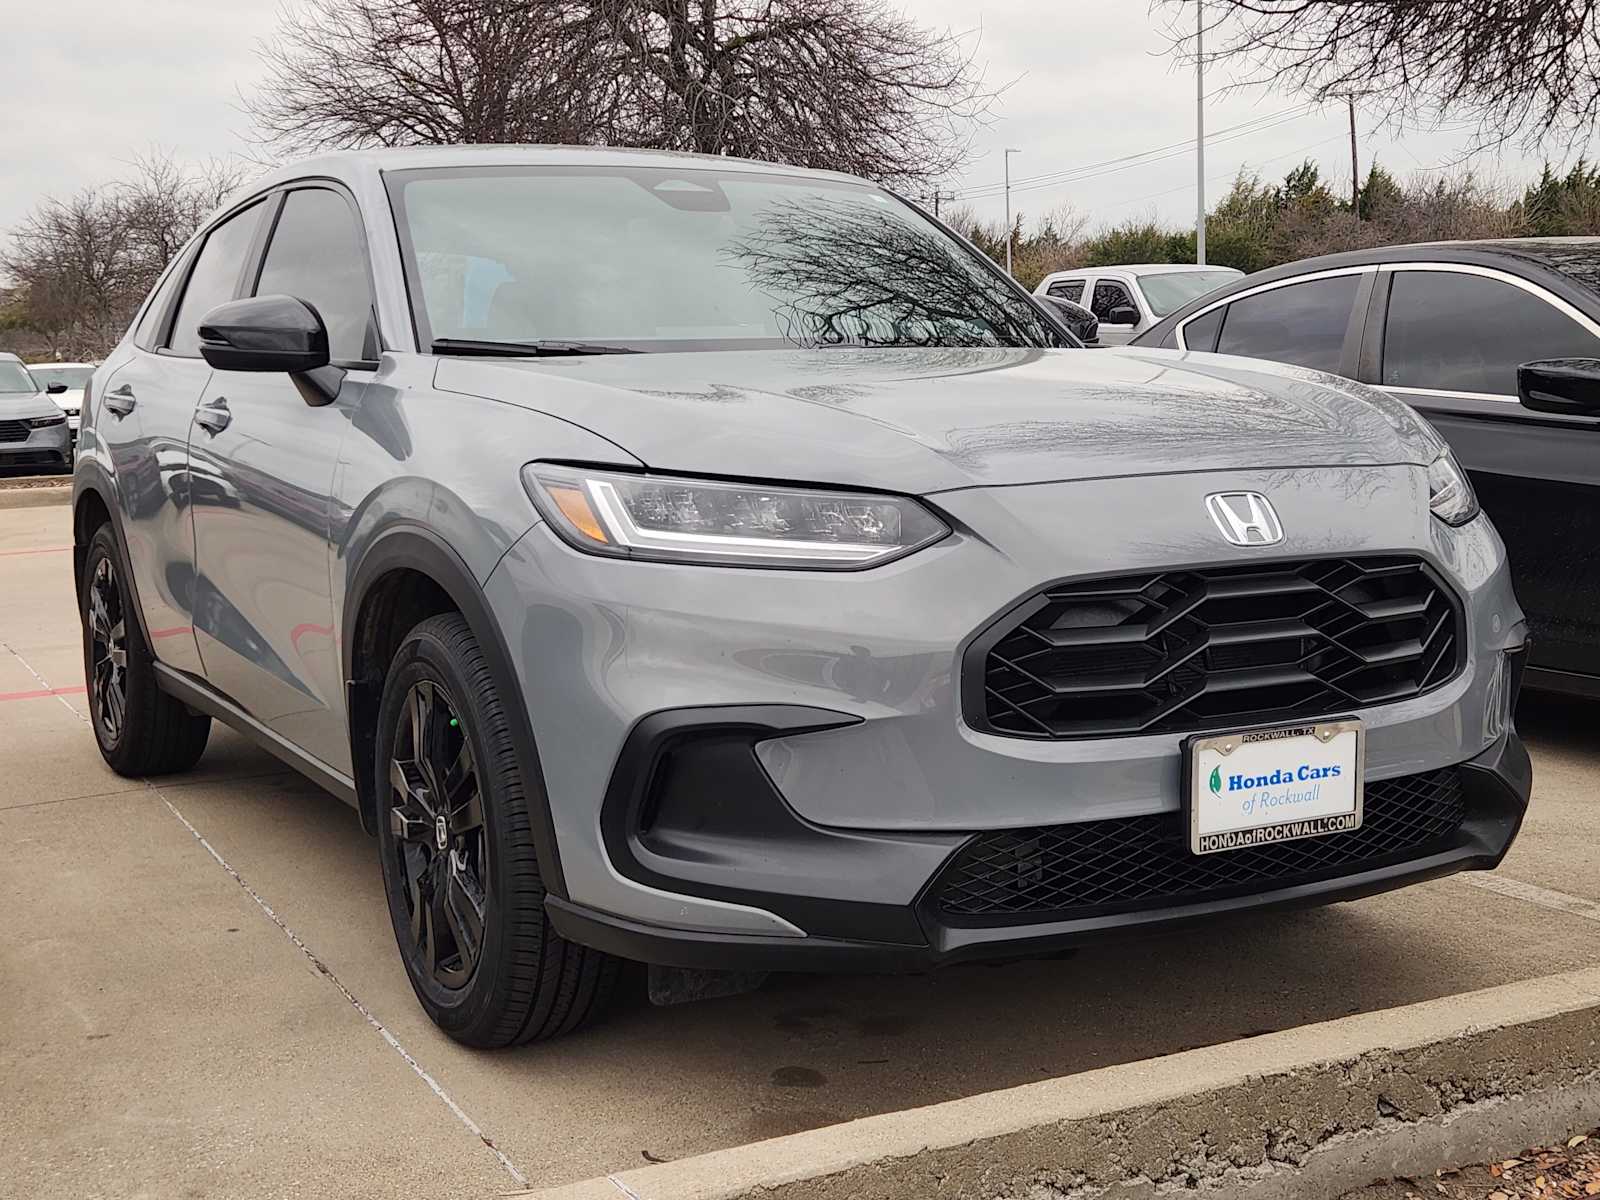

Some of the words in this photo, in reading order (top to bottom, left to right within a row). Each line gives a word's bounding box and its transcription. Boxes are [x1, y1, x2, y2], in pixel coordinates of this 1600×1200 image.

[1302, 727, 1316, 736] TX
[1228, 769, 1293, 791] Honda
[1297, 764, 1341, 781] Cars
[1242, 798, 1256, 815] of
[1260, 784, 1320, 808] Rockwall
[1200, 814, 1355, 852] HONDAofROCKWALL.COM
